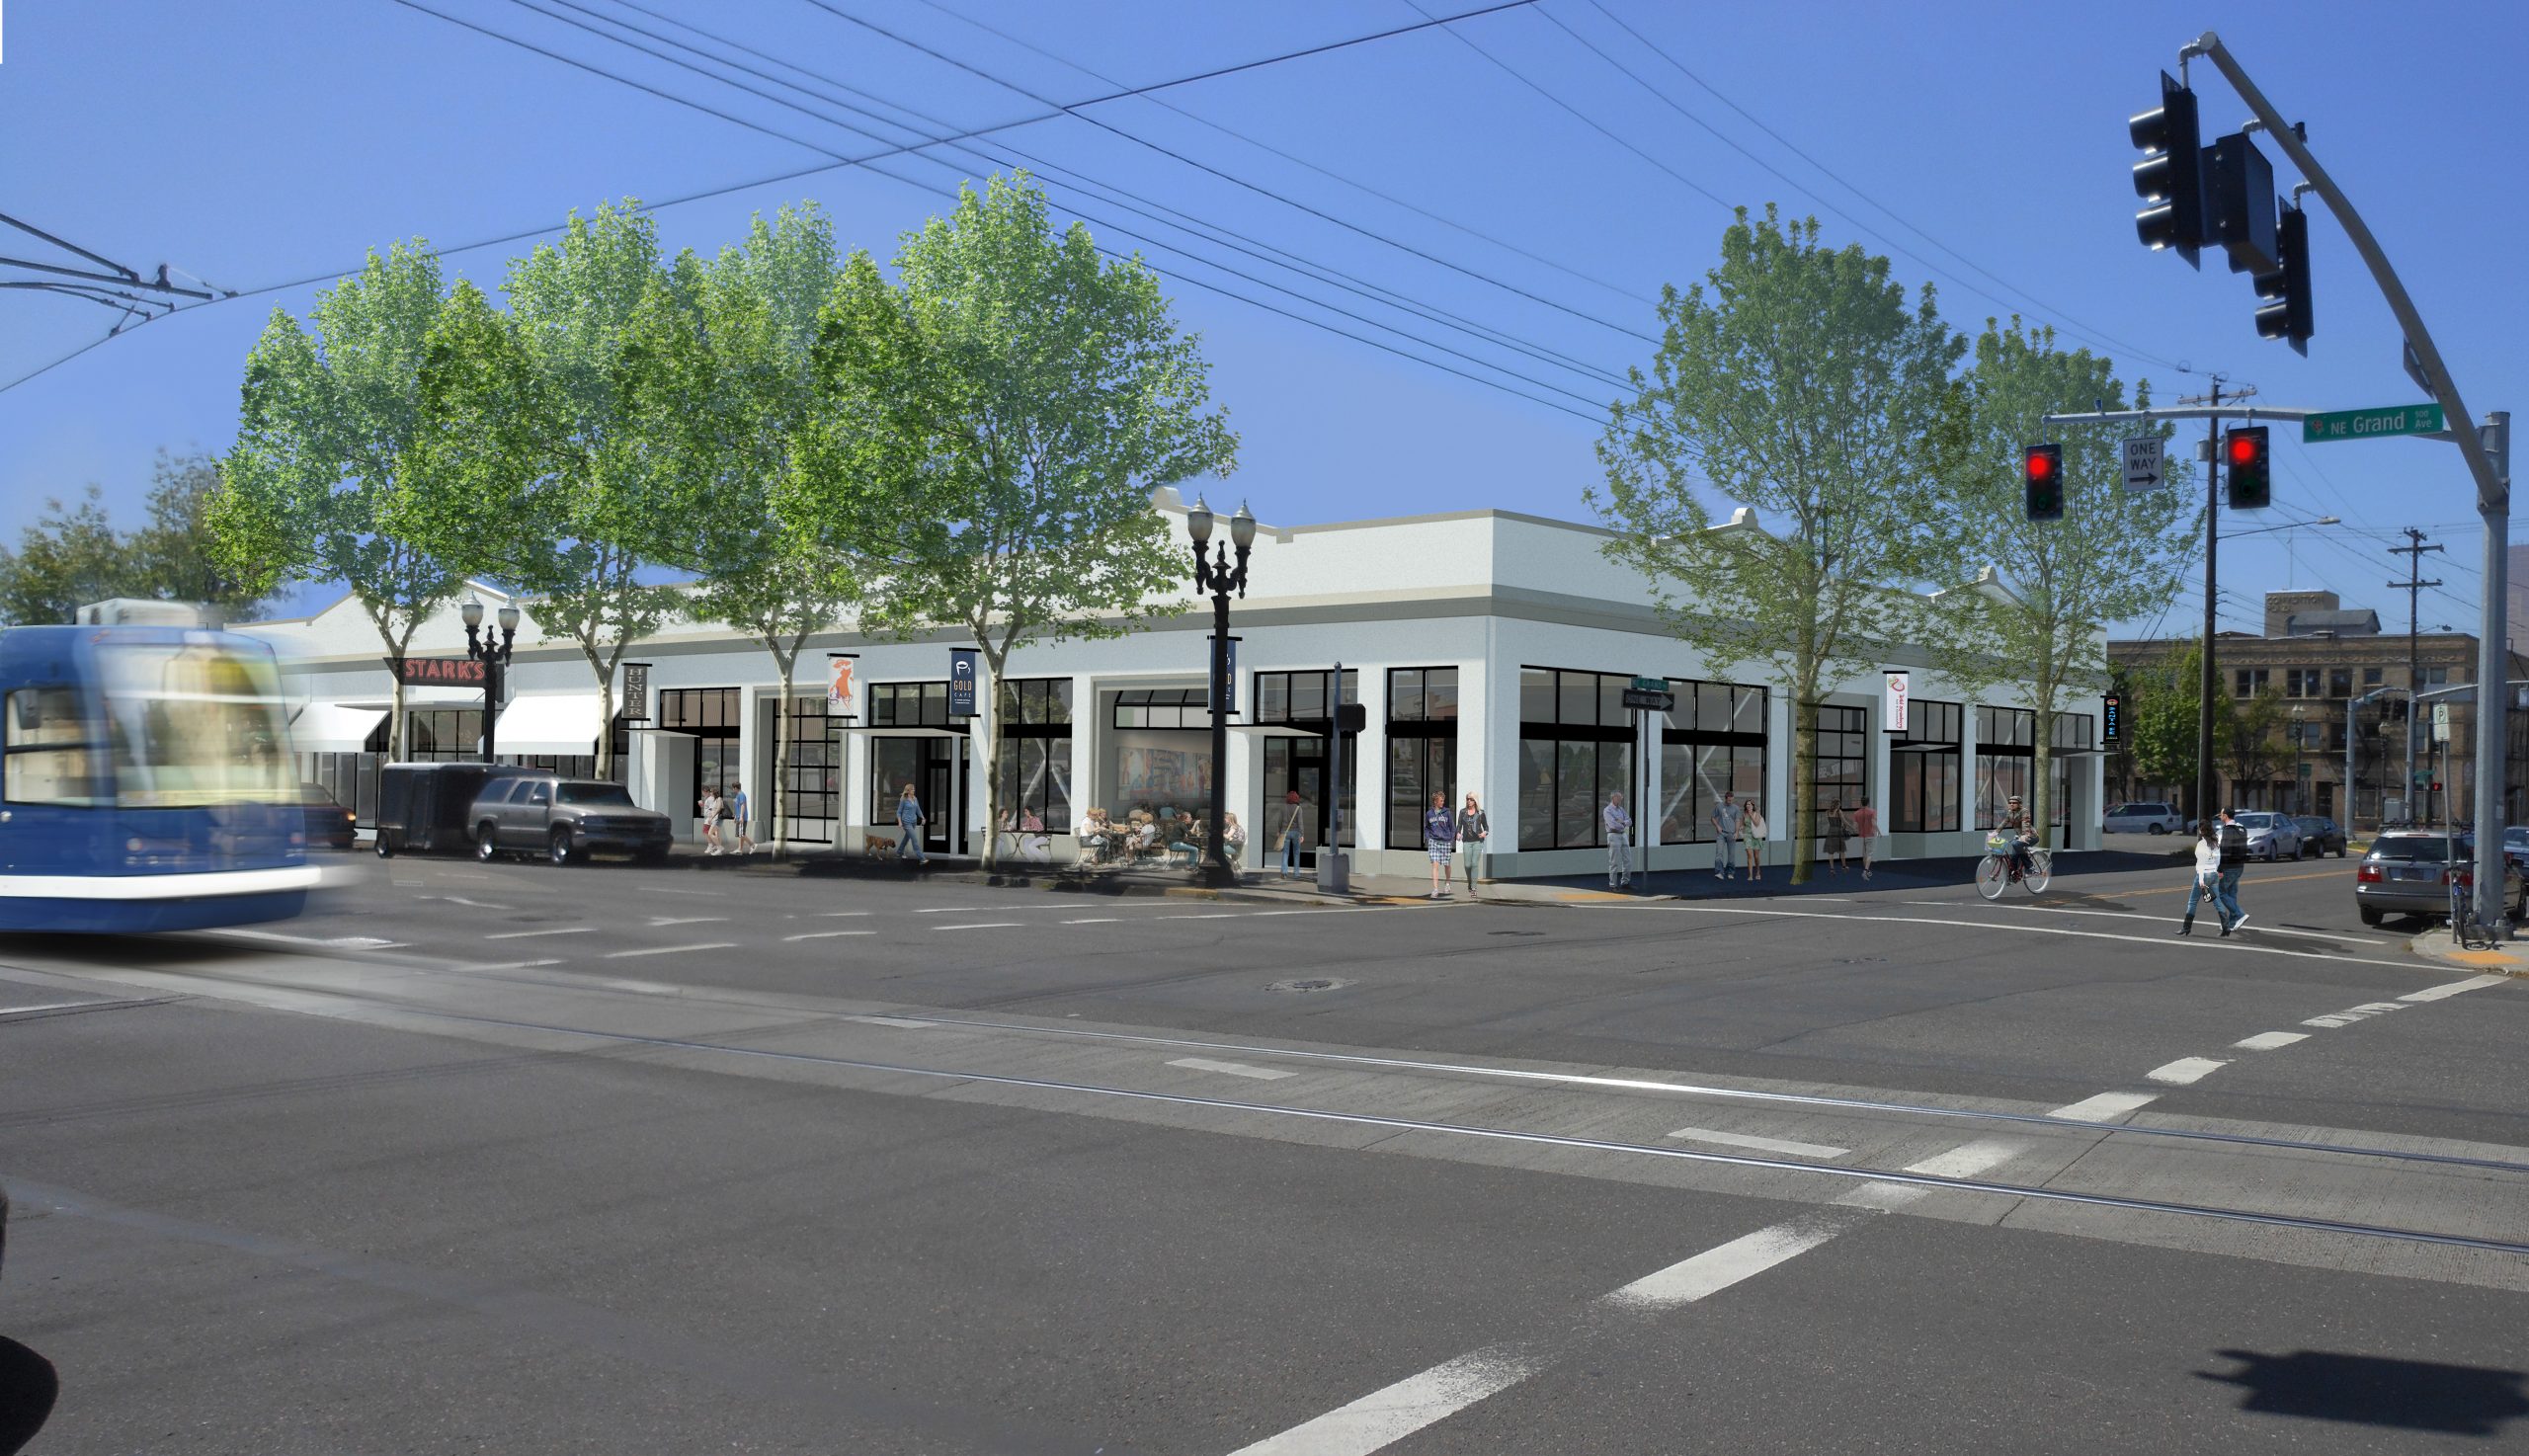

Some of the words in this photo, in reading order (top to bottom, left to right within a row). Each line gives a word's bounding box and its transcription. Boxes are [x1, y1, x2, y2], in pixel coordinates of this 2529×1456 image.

[2330, 422, 2346, 435] NE
[2353, 412, 2405, 433] Grand
[2415, 419, 2431, 429] Ave
[2130, 443, 2156, 455] ONE
[2130, 458, 2156, 470] WAY
[405, 658, 485, 681] STARK'S
[626, 668, 643, 715] HUNTER
[953, 680, 972, 691] GOLD
